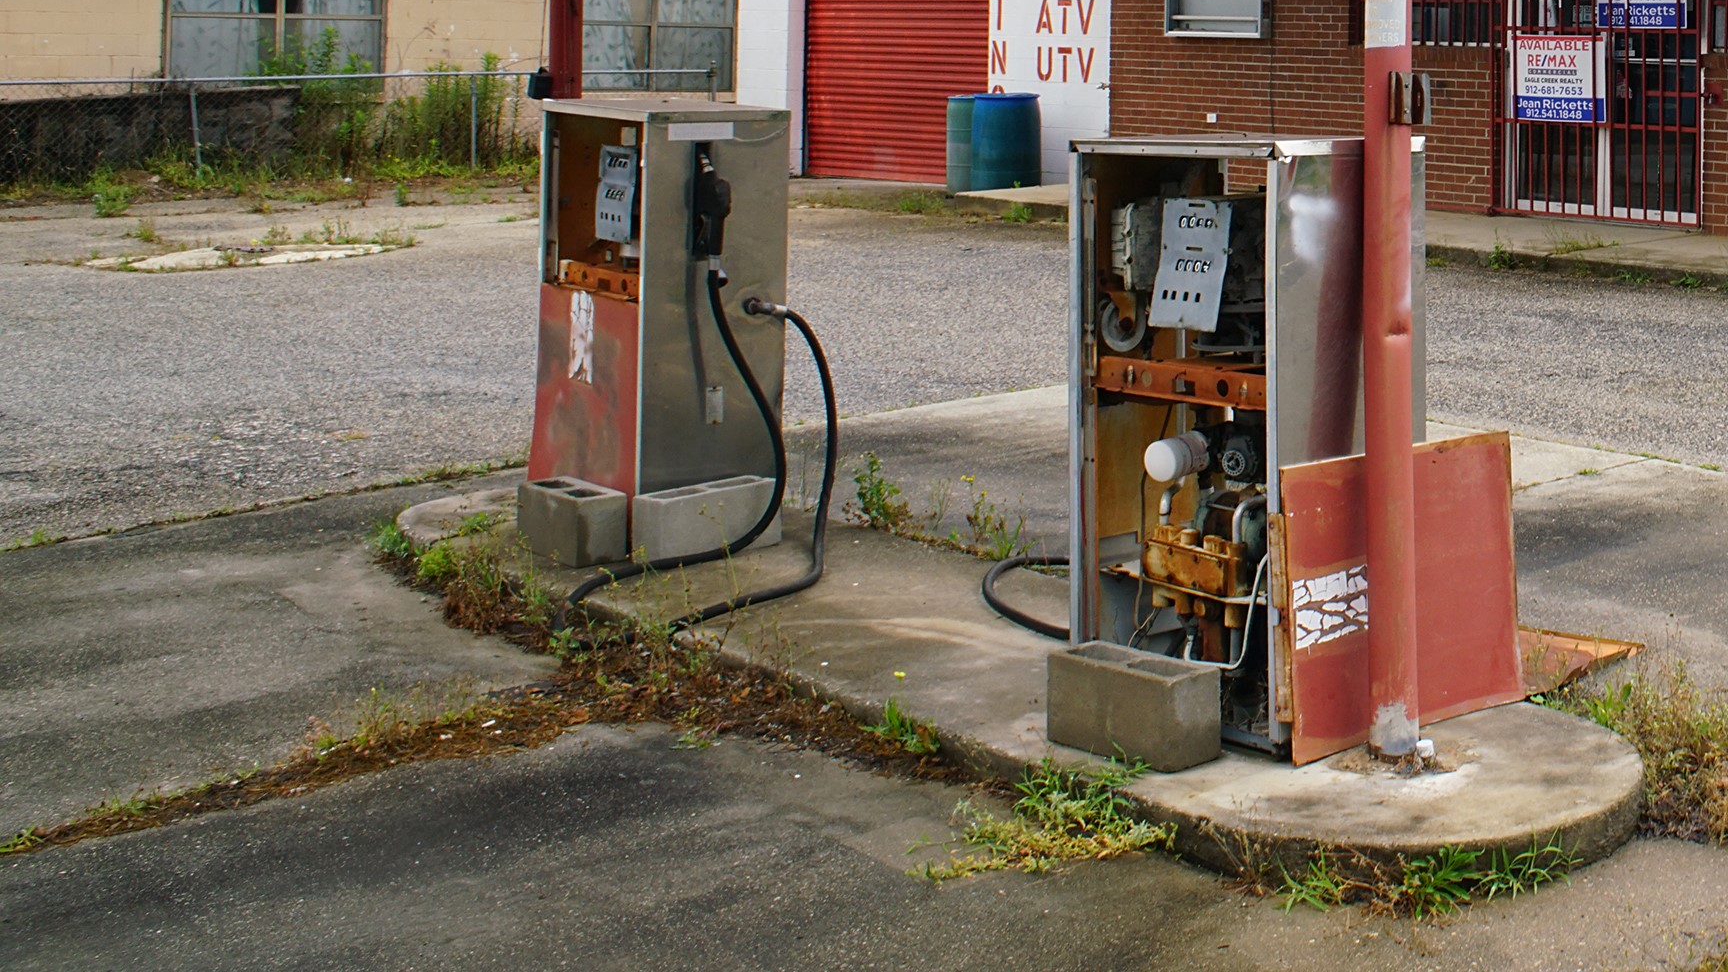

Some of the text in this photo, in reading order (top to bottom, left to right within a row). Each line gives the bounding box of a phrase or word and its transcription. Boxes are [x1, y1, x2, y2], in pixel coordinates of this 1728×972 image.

[1602, 5, 1624, 16] Jan
[1035, 0, 1095, 35] ATV
[1611, 16, 1662, 26] 912.41.1848
[1519, 40, 1589, 51] AVAILABLE
[1037, 46, 1095, 84] UTV
[1527, 54, 1577, 68] RE/MAX
[1525, 85, 1583, 95] 912-681-7653
[1517, 98, 1593, 110] Jean Ricketts
[1526, 108, 1582, 119] 912.541.1848
